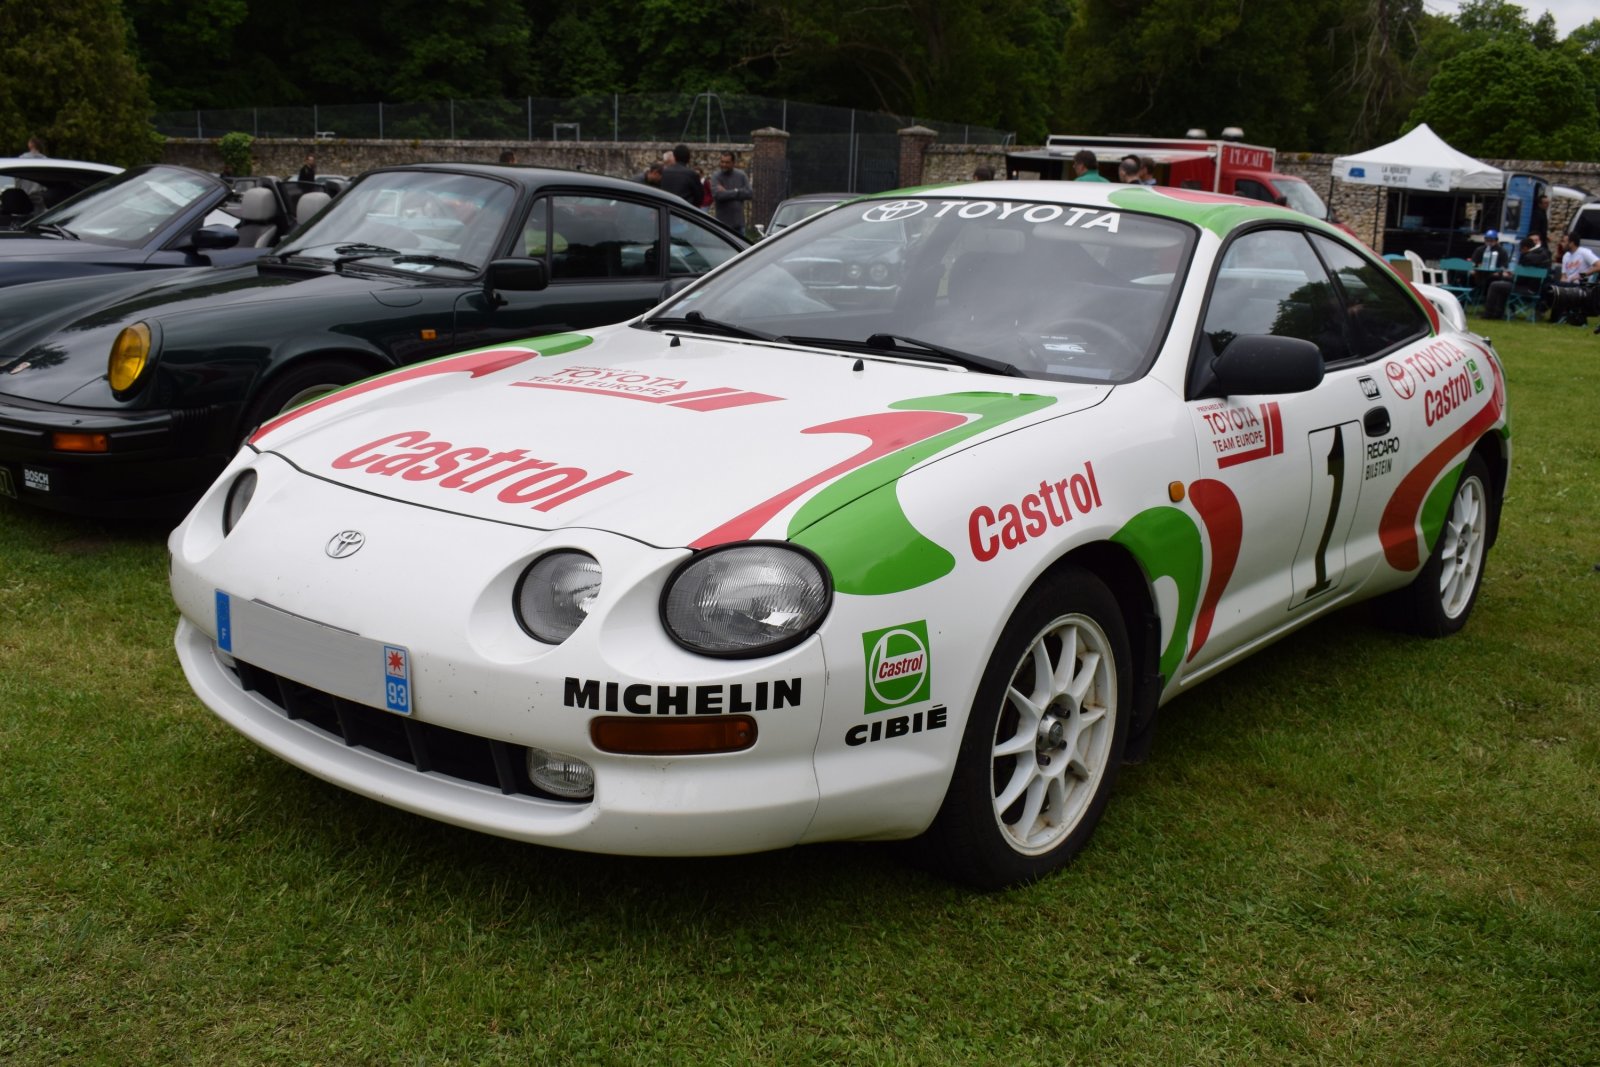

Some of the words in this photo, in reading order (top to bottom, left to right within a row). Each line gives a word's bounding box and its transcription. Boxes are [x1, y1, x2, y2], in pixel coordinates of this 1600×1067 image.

[934, 201, 1121, 233] TOYOTA
[1405, 340, 1466, 382] TOYOTA
[528, 376, 585, 385] TEAM
[584, 381, 672, 396] EUROPE
[552, 368, 688, 390] TOYOTA
[1424, 366, 1472, 427] Castrol
[1203, 407, 1260, 435] TOYOTA
[1213, 437, 1235, 453] TEAM
[1236, 431, 1264, 448] EUROPE
[1367, 437, 1400, 460] RECARO
[24, 469, 49, 485] BOSCH
[331, 431, 634, 513] Castrol
[1365, 459, 1392, 480] BILSTEIN
[968, 461, 1102, 562] Castrol
[1304, 425, 1345, 599] 1
[879, 654, 923, 679] Castrol
[387, 682, 407, 706] 93
[564, 677, 802, 715] MICHELIN
[845, 704, 947, 747] CIBIÉ
